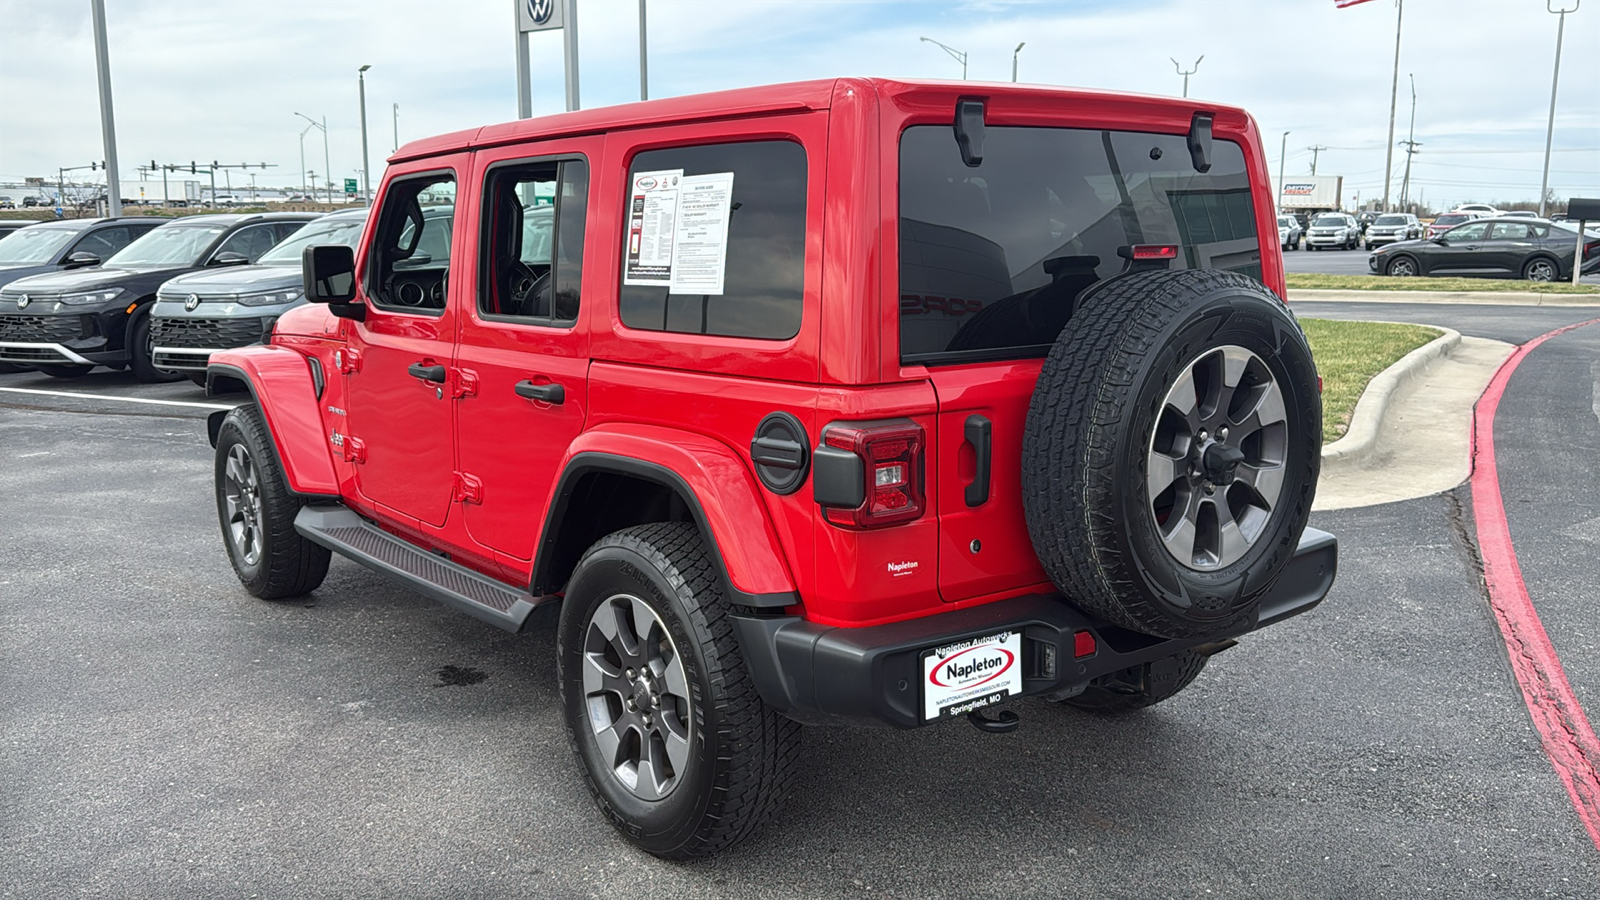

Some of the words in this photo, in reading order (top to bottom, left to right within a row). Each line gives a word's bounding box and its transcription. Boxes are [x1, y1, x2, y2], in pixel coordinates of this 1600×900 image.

[887, 561, 918, 572] Napleton
[934, 641, 971, 656] Napleton
[946, 656, 1002, 681] Napleton
[950, 698, 987, 716] Springfield,
[989, 693, 1001, 704] MO
